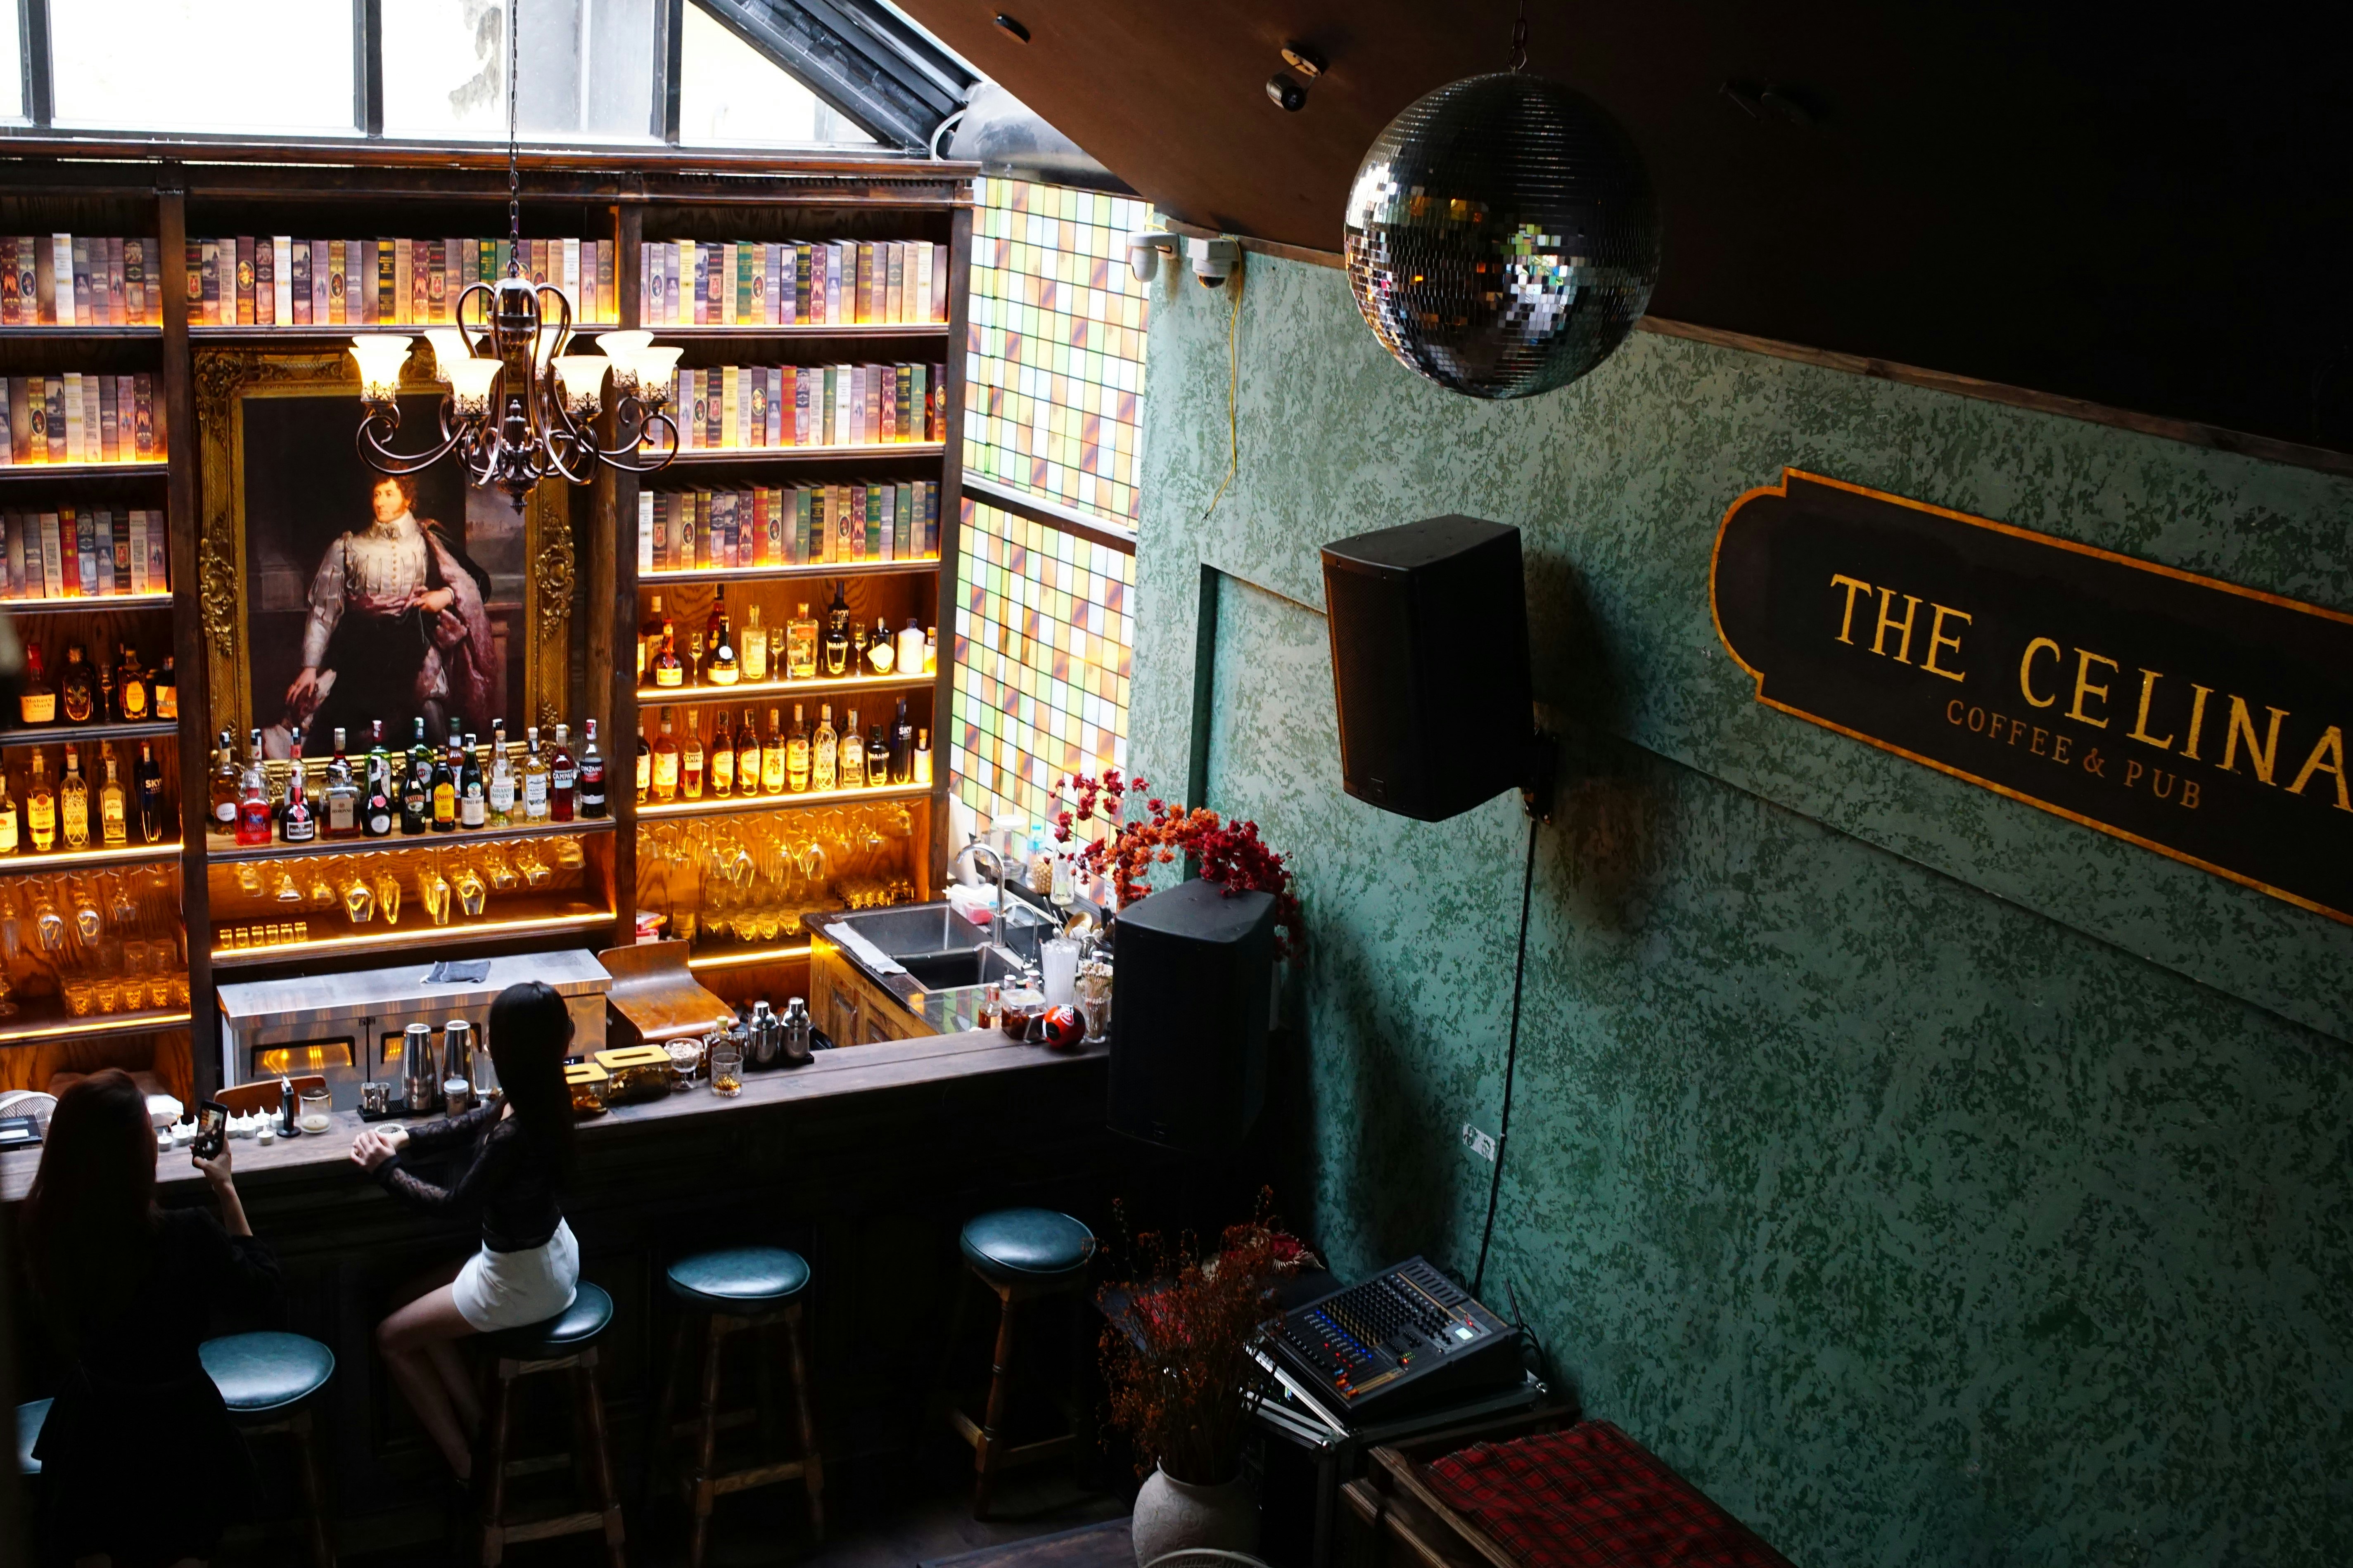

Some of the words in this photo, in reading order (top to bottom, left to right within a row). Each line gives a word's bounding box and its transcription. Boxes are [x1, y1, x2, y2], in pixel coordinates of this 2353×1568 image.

[1830, 573, 1972, 683] THE
[2020, 637, 2353, 813] CELINA
[1947, 699, 2073, 765] COFFEE
[2083, 748, 2105, 778] &
[2124, 760, 2201, 810] PUB
